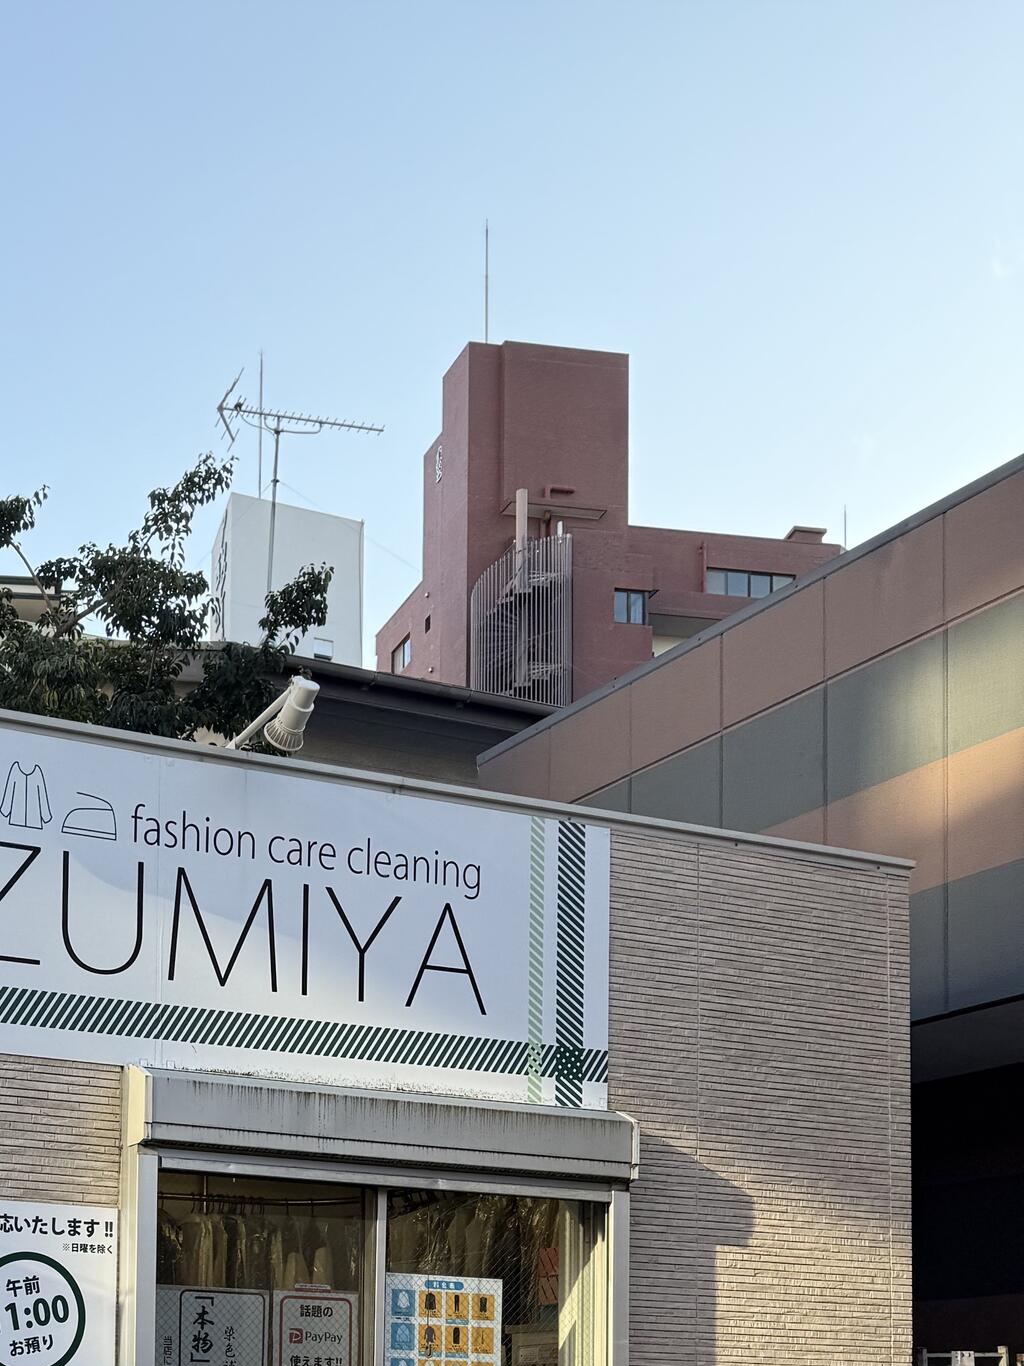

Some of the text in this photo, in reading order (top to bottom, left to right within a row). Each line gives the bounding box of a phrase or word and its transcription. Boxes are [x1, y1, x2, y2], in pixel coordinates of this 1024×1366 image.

[131, 803, 483, 901] fashion care cleaning
[62, 1243, 114, 1255] ※日曜を除く
[5, 1275, 41, 1298] 午前
[299, 1304, 334, 1318] 話題の
[8, 1335, 55, 1357] お預り
[305, 1331, 343, 1344] PayPay
